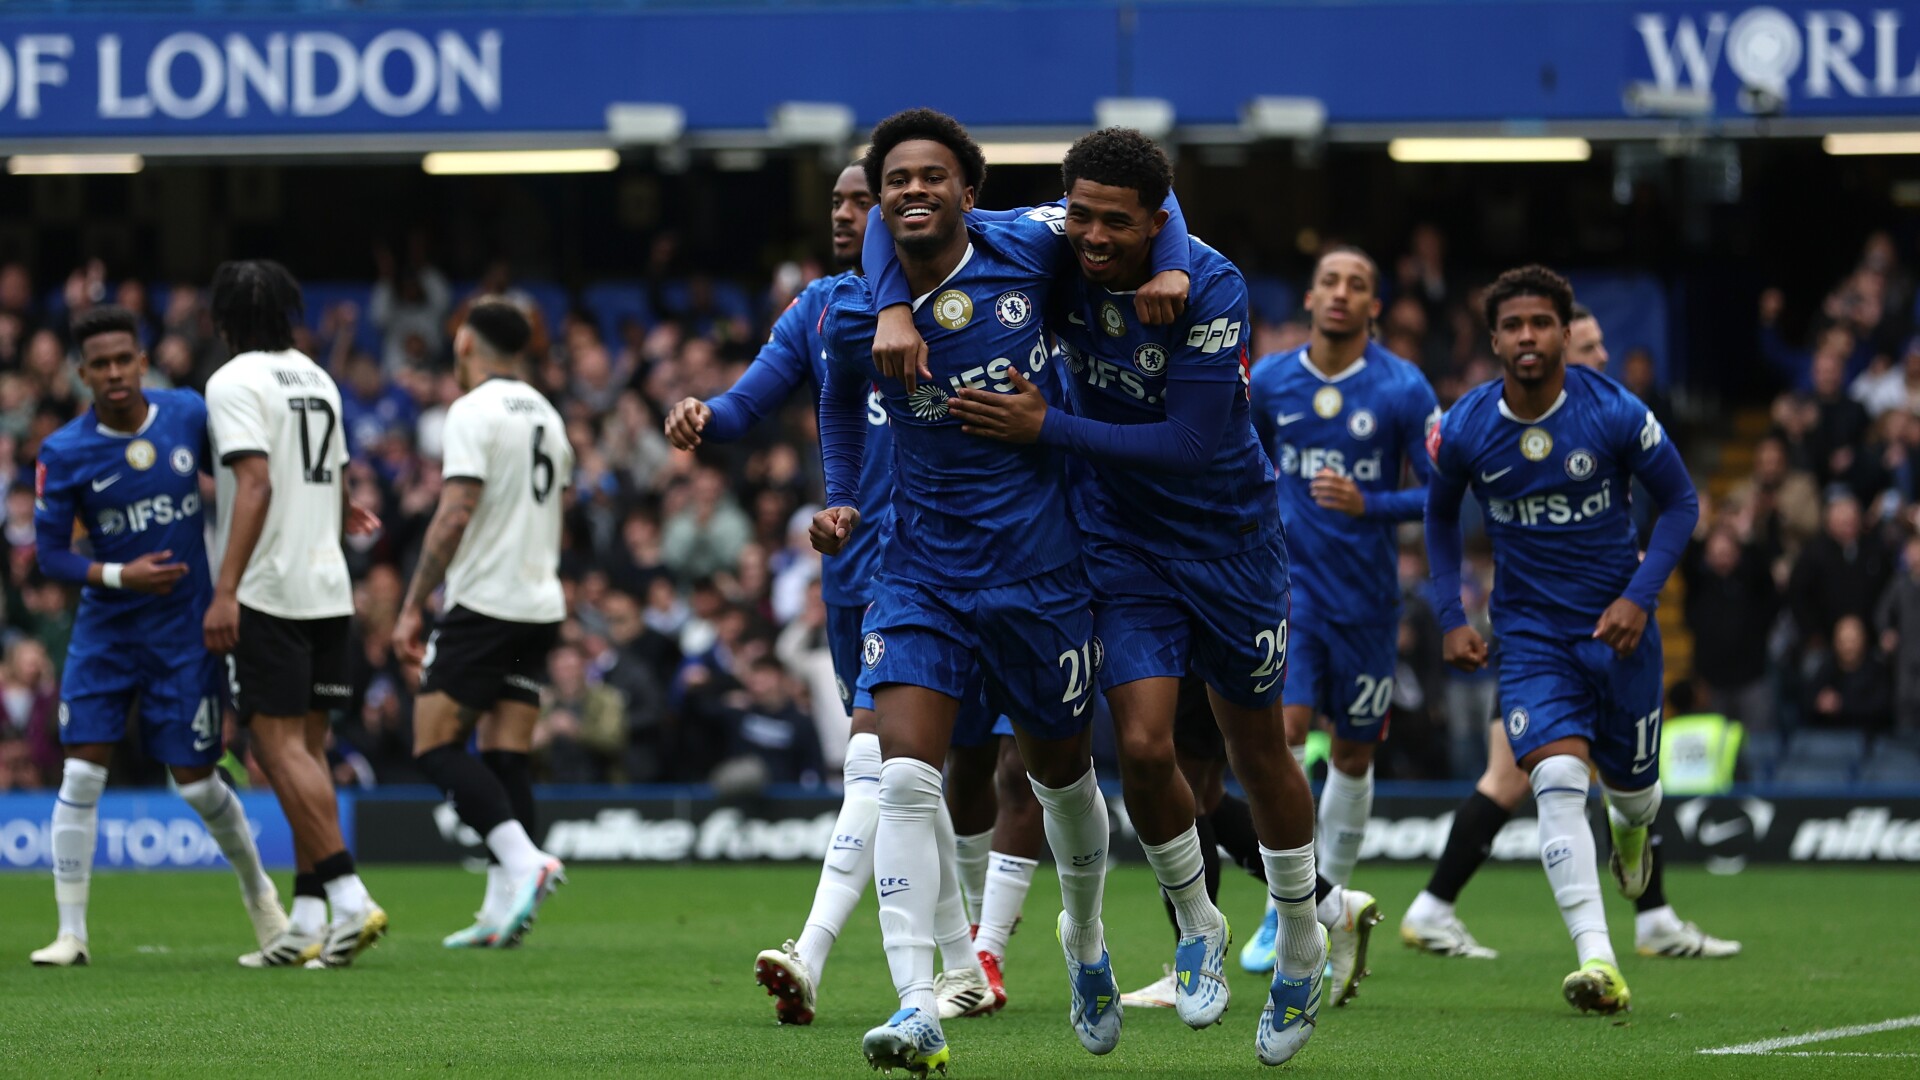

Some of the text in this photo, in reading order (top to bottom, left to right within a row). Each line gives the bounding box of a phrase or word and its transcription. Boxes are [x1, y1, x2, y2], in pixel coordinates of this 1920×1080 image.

[0, 29, 502, 119] F LONDON
[951, 316, 967, 328] FIFA
[998, 292, 1020, 308] CHELSEA
[1188, 323, 1240, 347] FPT
[287, 396, 336, 484] 12
[532, 423, 555, 506] 6
[1516, 479, 1611, 526] IFS.ai
[1058, 639, 1093, 703] 21
[1250, 618, 1287, 677] 29
[1347, 673, 1393, 717] 20
[1633, 706, 1661, 762] 17
[836, 834, 864, 848] CFC
[879, 877, 909, 887] CFC
